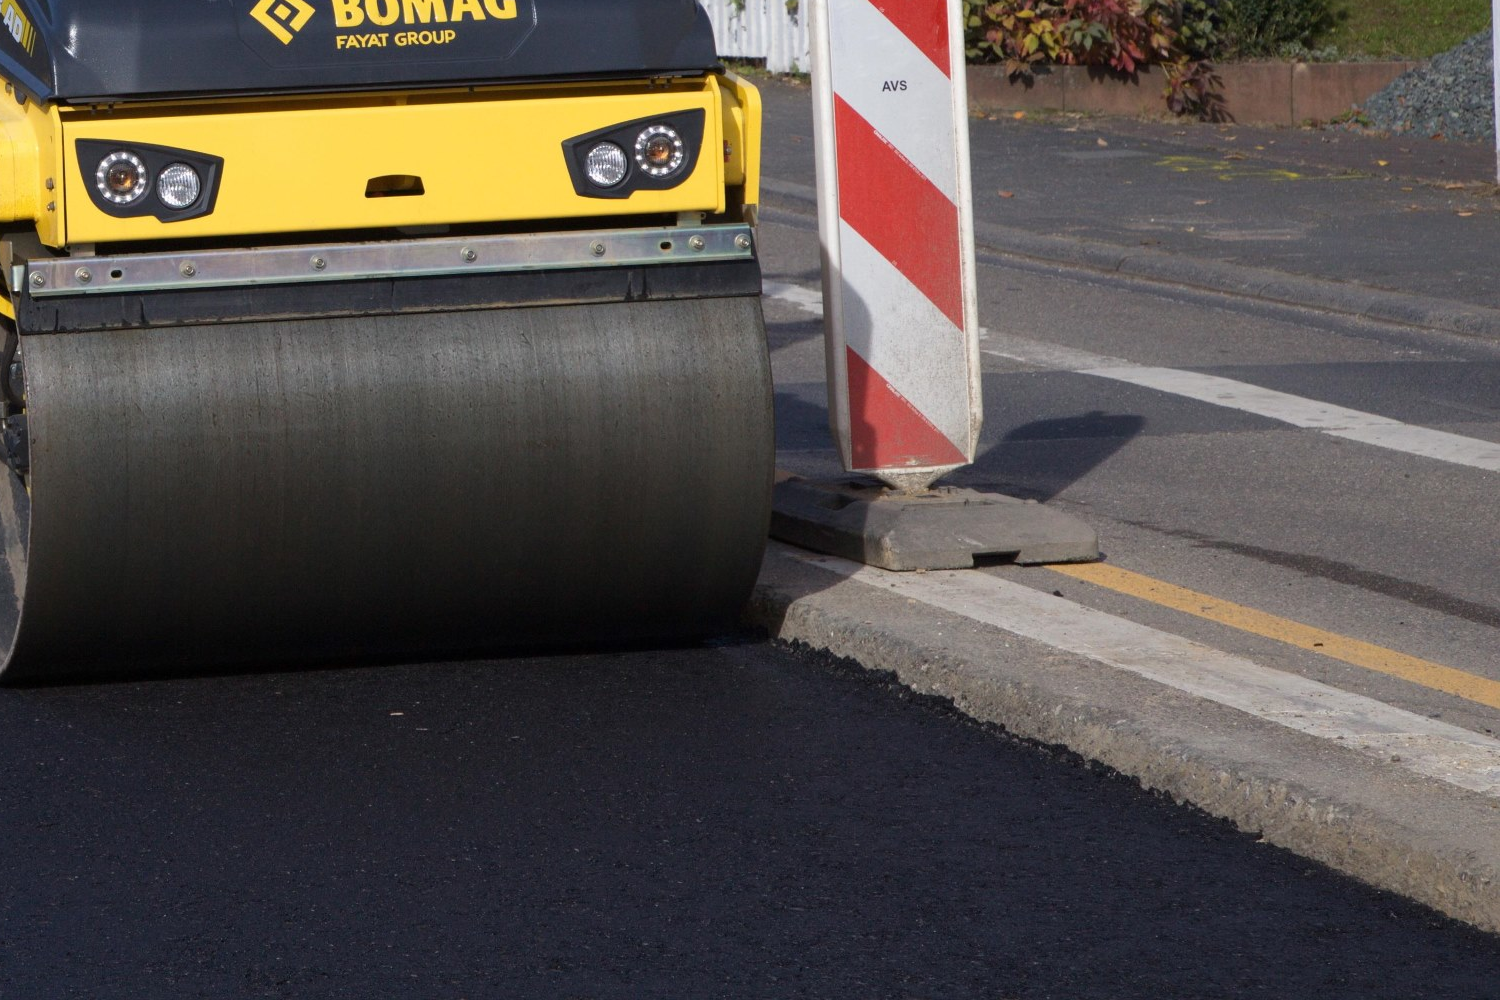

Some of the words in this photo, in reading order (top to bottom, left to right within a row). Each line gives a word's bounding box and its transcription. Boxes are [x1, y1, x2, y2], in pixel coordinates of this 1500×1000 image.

[3, 3, 23, 43] AD
[336, 32, 389, 49] FAYAT
[394, 29, 456, 48] GROUP
[882, 80, 908, 92] AVS
